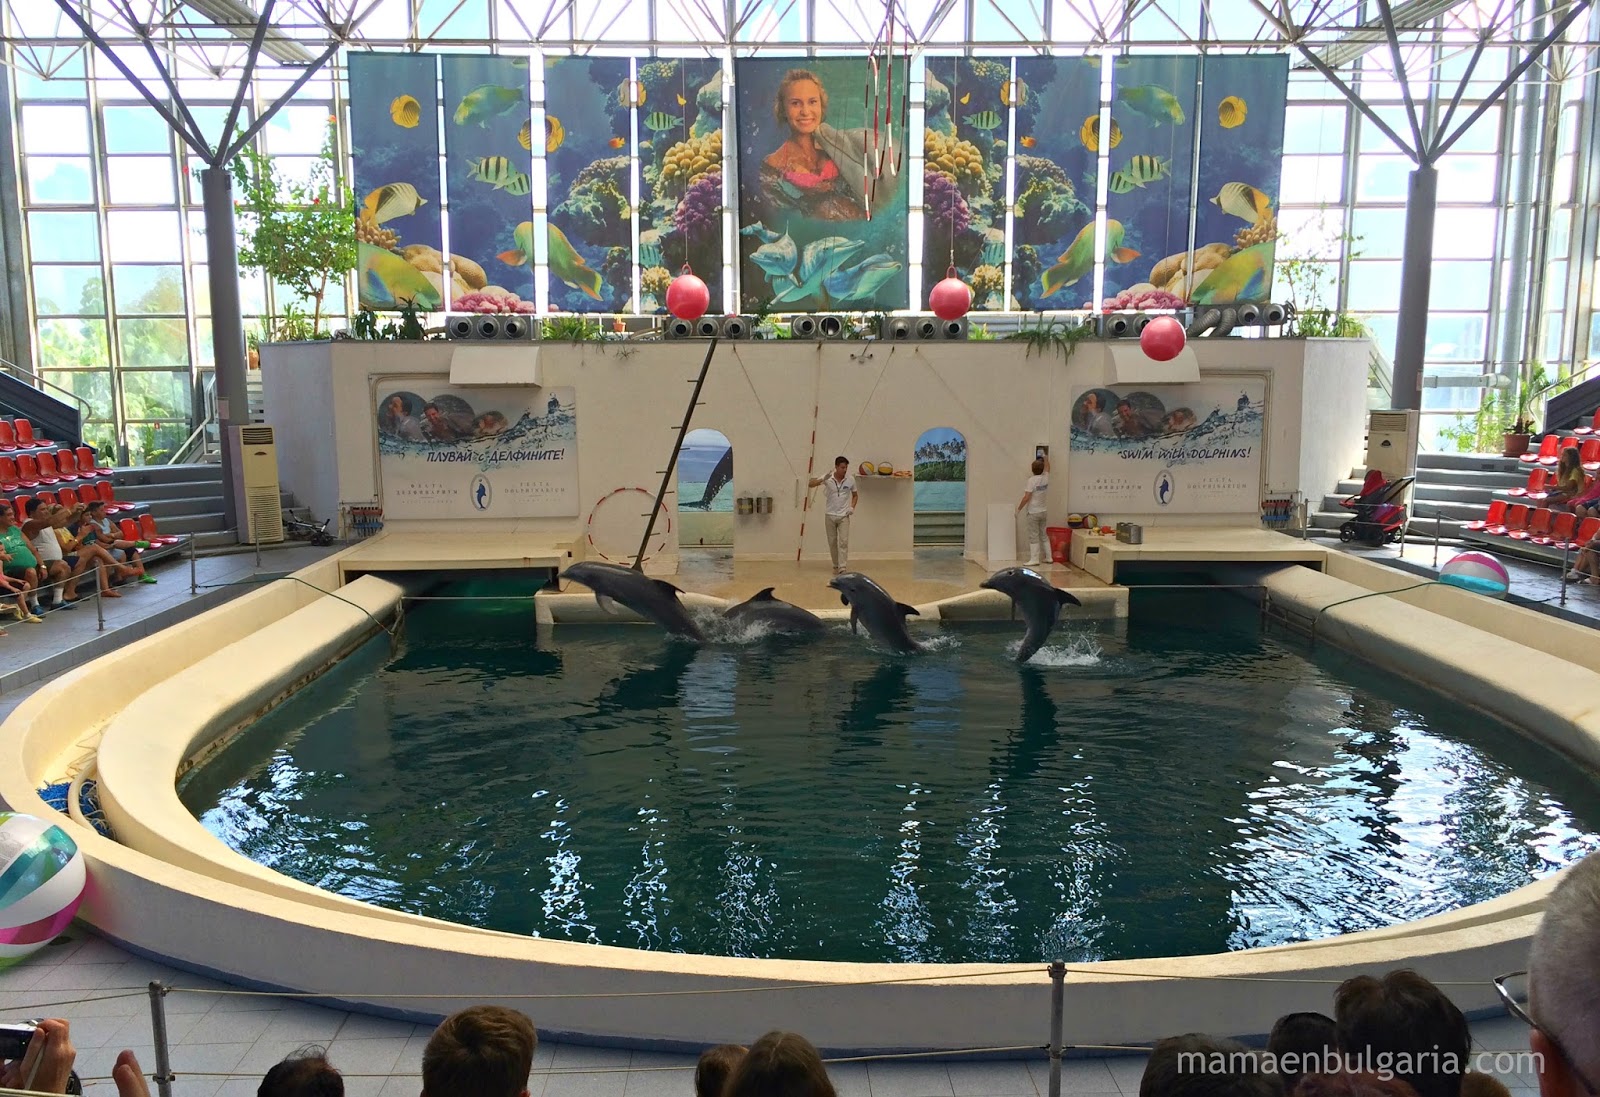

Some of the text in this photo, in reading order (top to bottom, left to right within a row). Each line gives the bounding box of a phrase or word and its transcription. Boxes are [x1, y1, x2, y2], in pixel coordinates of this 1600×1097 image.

[426, 449, 472, 463] ПЛУВАЙ
[488, 448, 565, 463] ДЕЛФИНИТЕ!
[1120, 446, 1252, 461] SWIM with DOLPHINS!
